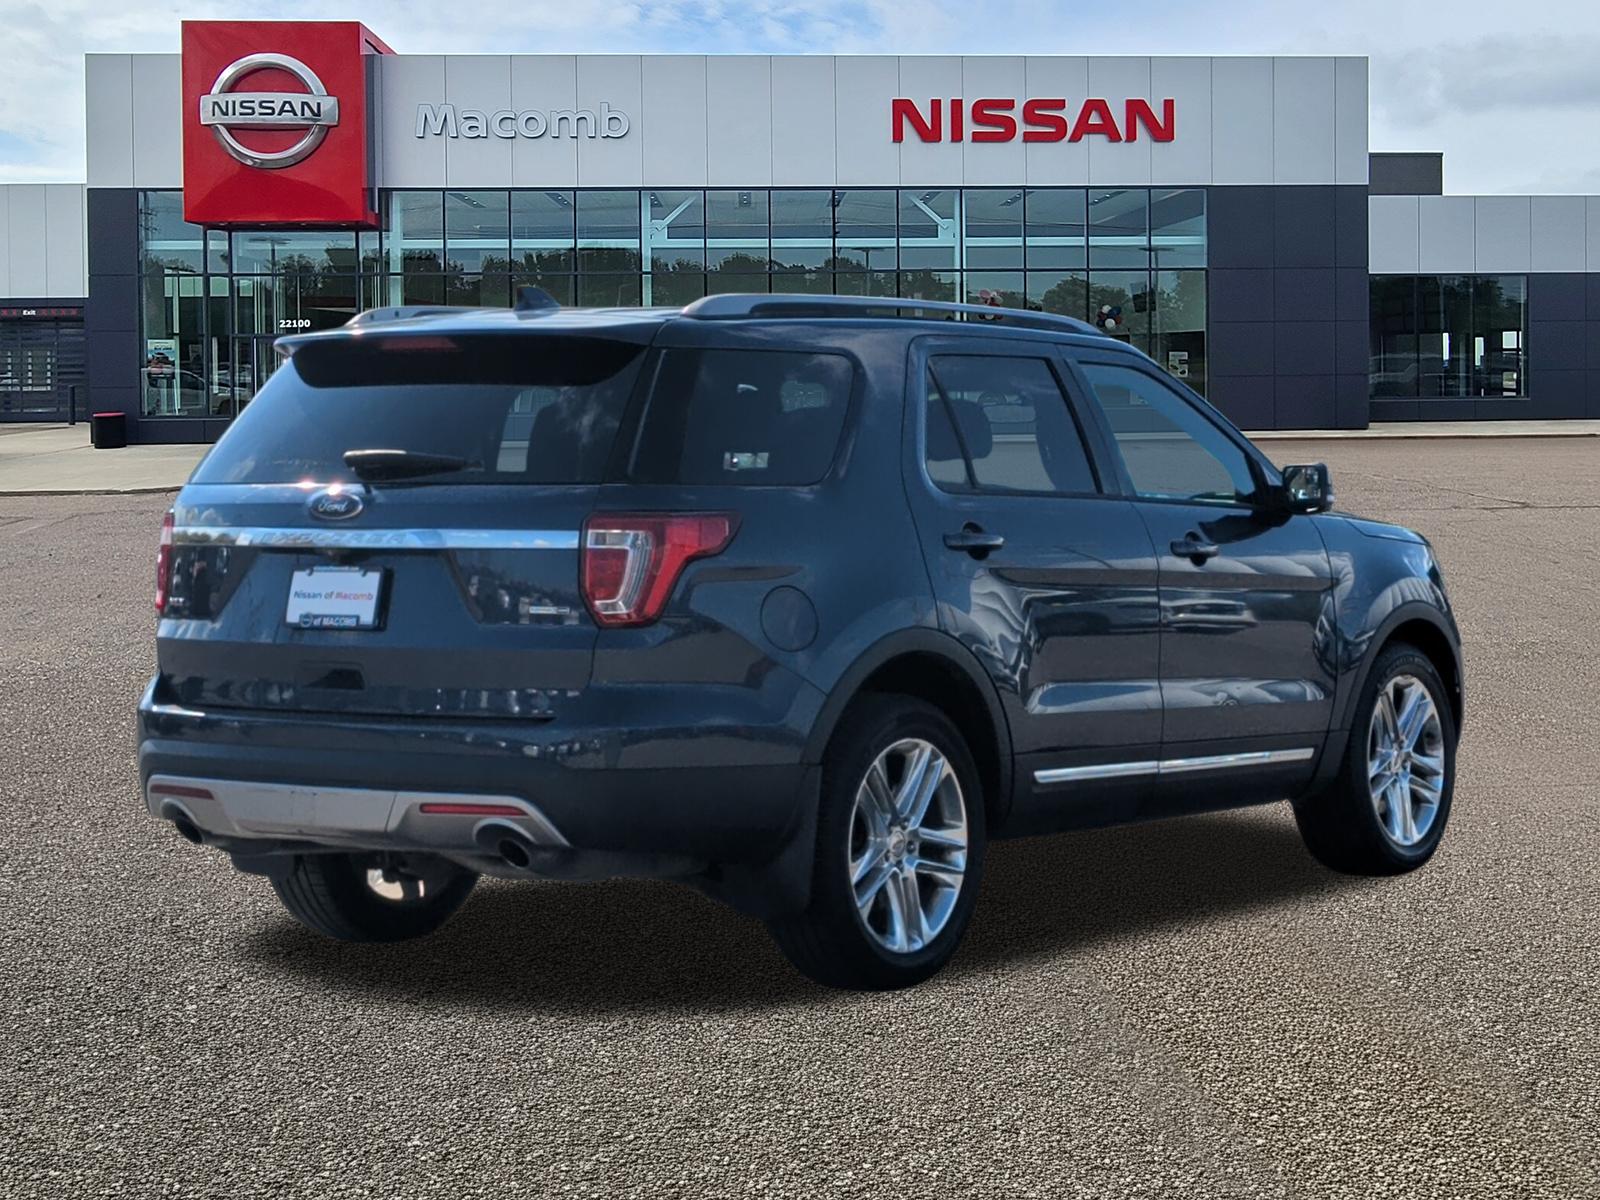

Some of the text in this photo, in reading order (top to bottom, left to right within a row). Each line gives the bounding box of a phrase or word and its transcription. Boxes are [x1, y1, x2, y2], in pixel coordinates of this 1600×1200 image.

[211, 100, 322, 117] NISSAN
[415, 101, 630, 139] Macomb
[891, 98, 1175, 143] NISSAN
[279, 319, 311, 328] 22100
[318, 498, 349, 512] Ford
[293, 589, 374, 601] Nissan of Macomb
